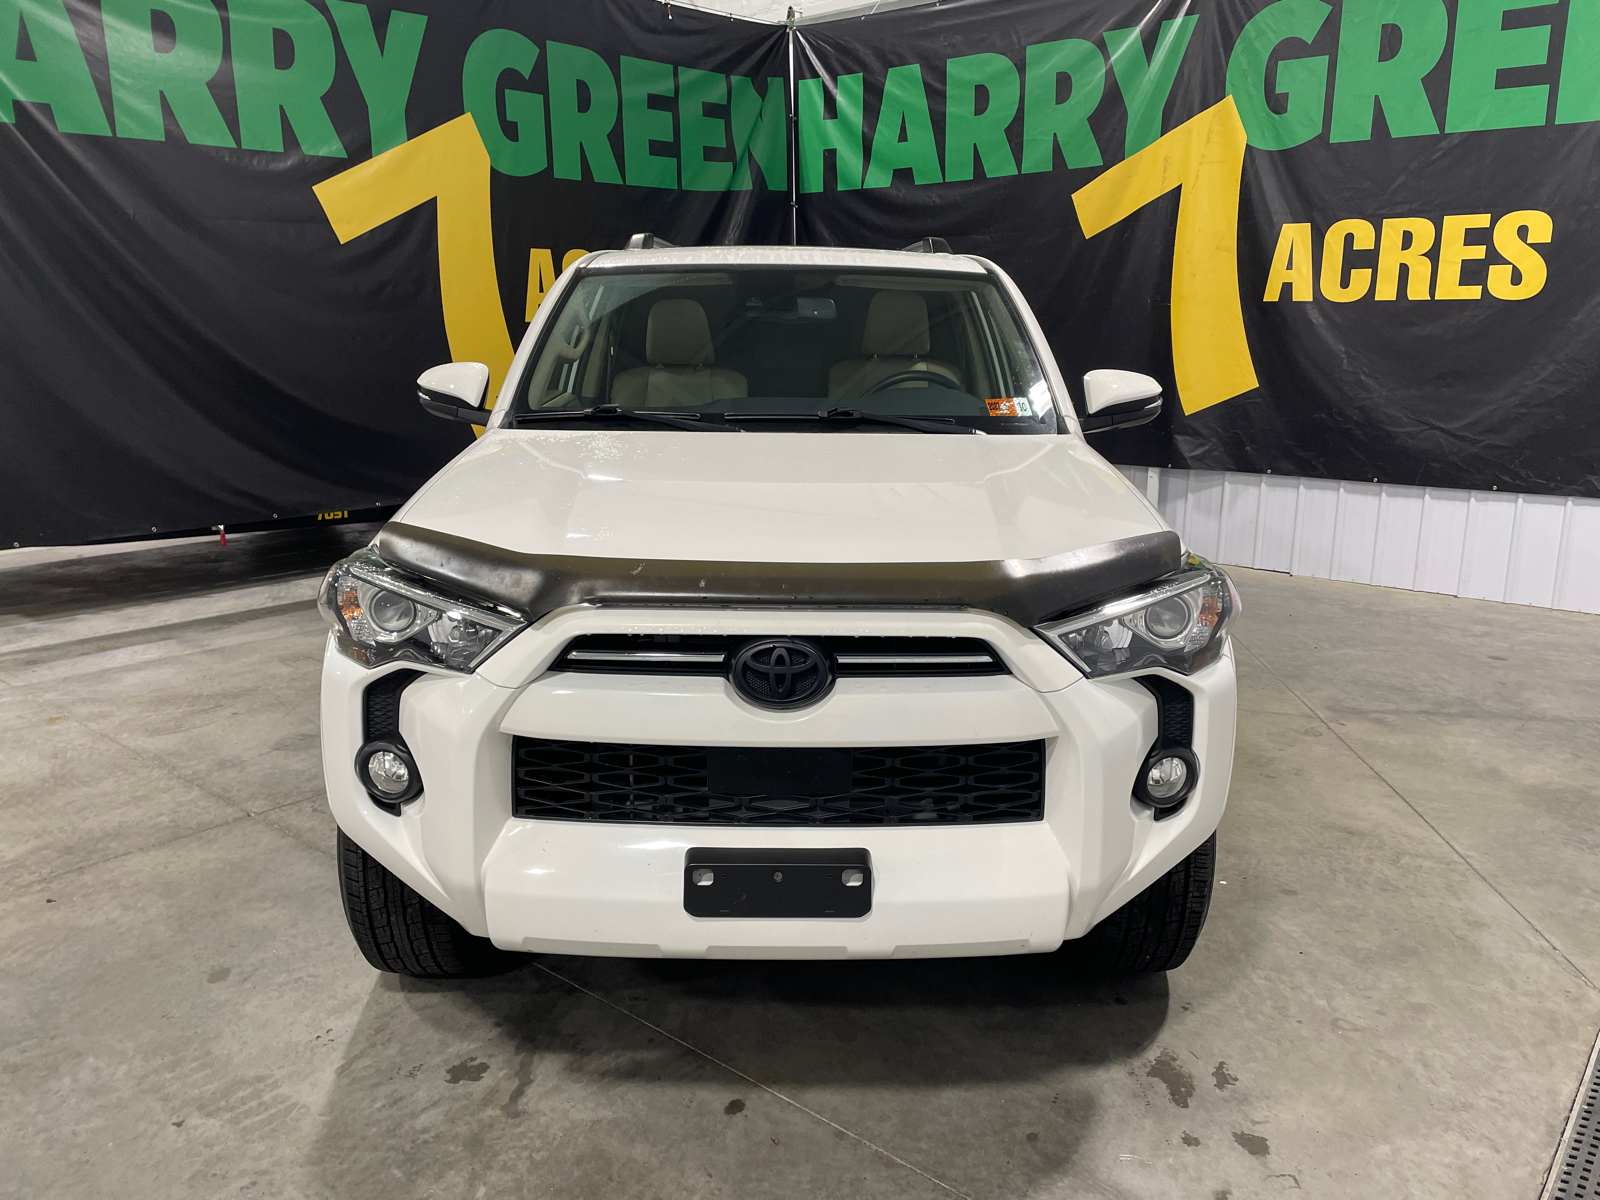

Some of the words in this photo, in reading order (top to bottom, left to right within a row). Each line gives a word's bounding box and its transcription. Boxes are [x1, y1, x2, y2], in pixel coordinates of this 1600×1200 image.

[462, 28, 788, 191] GREEN
[798, 14, 1200, 194] HARRY
[312, 112, 515, 436] 7
[1071, 95, 1259, 415] 7
[1262, 209, 1553, 302] ACRES
